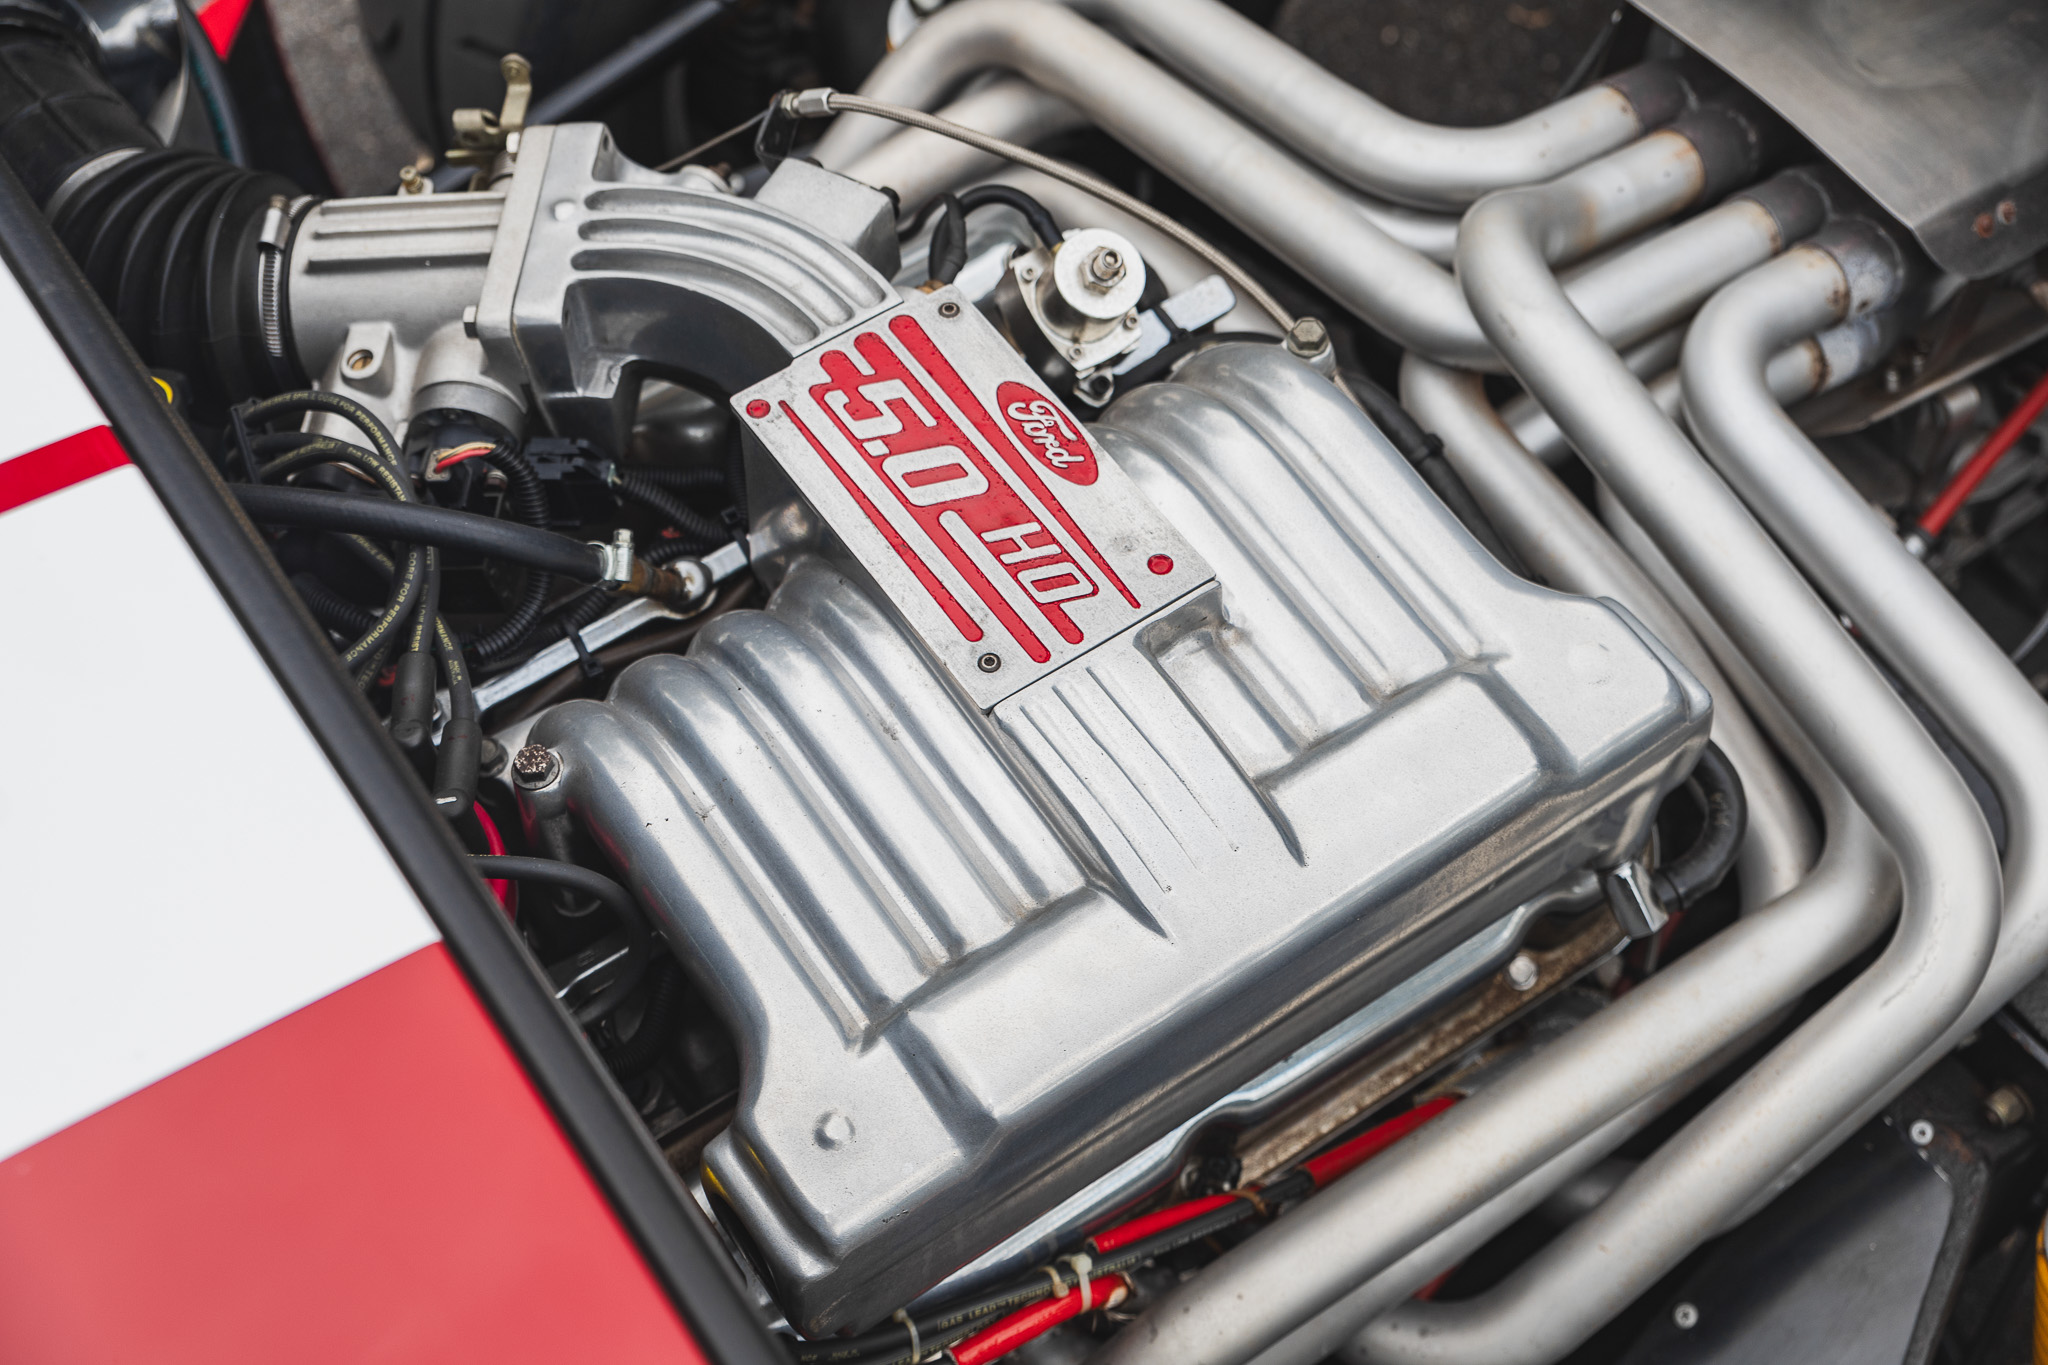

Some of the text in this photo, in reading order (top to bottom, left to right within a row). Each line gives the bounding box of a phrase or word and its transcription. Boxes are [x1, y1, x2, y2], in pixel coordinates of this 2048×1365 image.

[340, 401, 356, 415] FOR
[355, 410, 398, 467] PERFORMANCE
[362, 454, 380, 468] LOW
[824, 379, 990, 507] 5.0
[1007, 400, 1085, 469] Ford
[396, 583, 411, 603] FOR
[404, 552, 417, 580] CORE
[346, 604, 401, 663] PERFORMANCE
